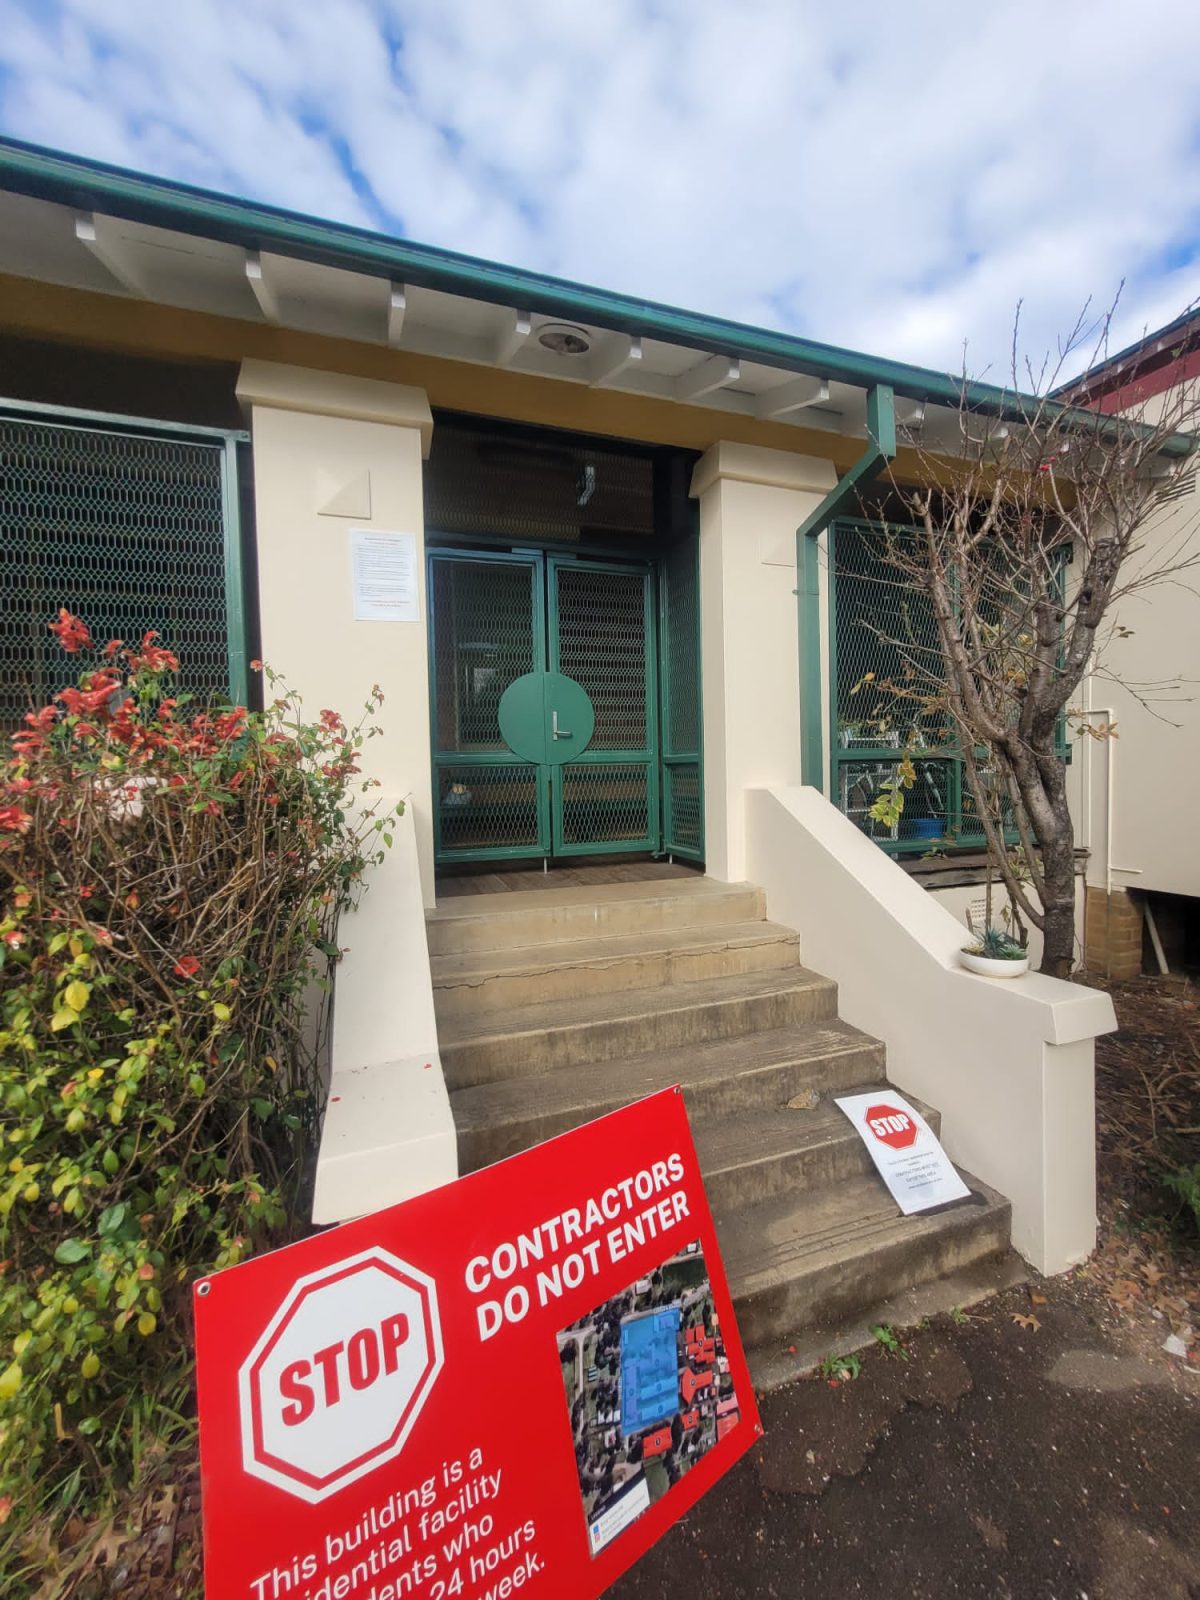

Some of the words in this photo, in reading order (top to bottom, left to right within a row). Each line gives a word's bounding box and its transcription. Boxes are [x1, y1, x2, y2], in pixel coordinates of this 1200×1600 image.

[870, 1113, 910, 1137] STOP
[464, 1153, 685, 1293] CONTRACTORS
[476, 1285, 530, 1342] DO
[536, 1240, 601, 1307] NOT
[606, 1190, 691, 1264] ENTER
[279, 1312, 410, 1427] STOP
[249, 1554, 318, 1600] This
[325, 1475, 437, 1565] building
[442, 1460, 463, 1488] is
[469, 1447, 483, 1470] a
[418, 1468, 502, 1541] facility
[442, 1514, 494, 1562] who
[429, 1567, 465, 1600] 24
[469, 1519, 536, 1583] hours
